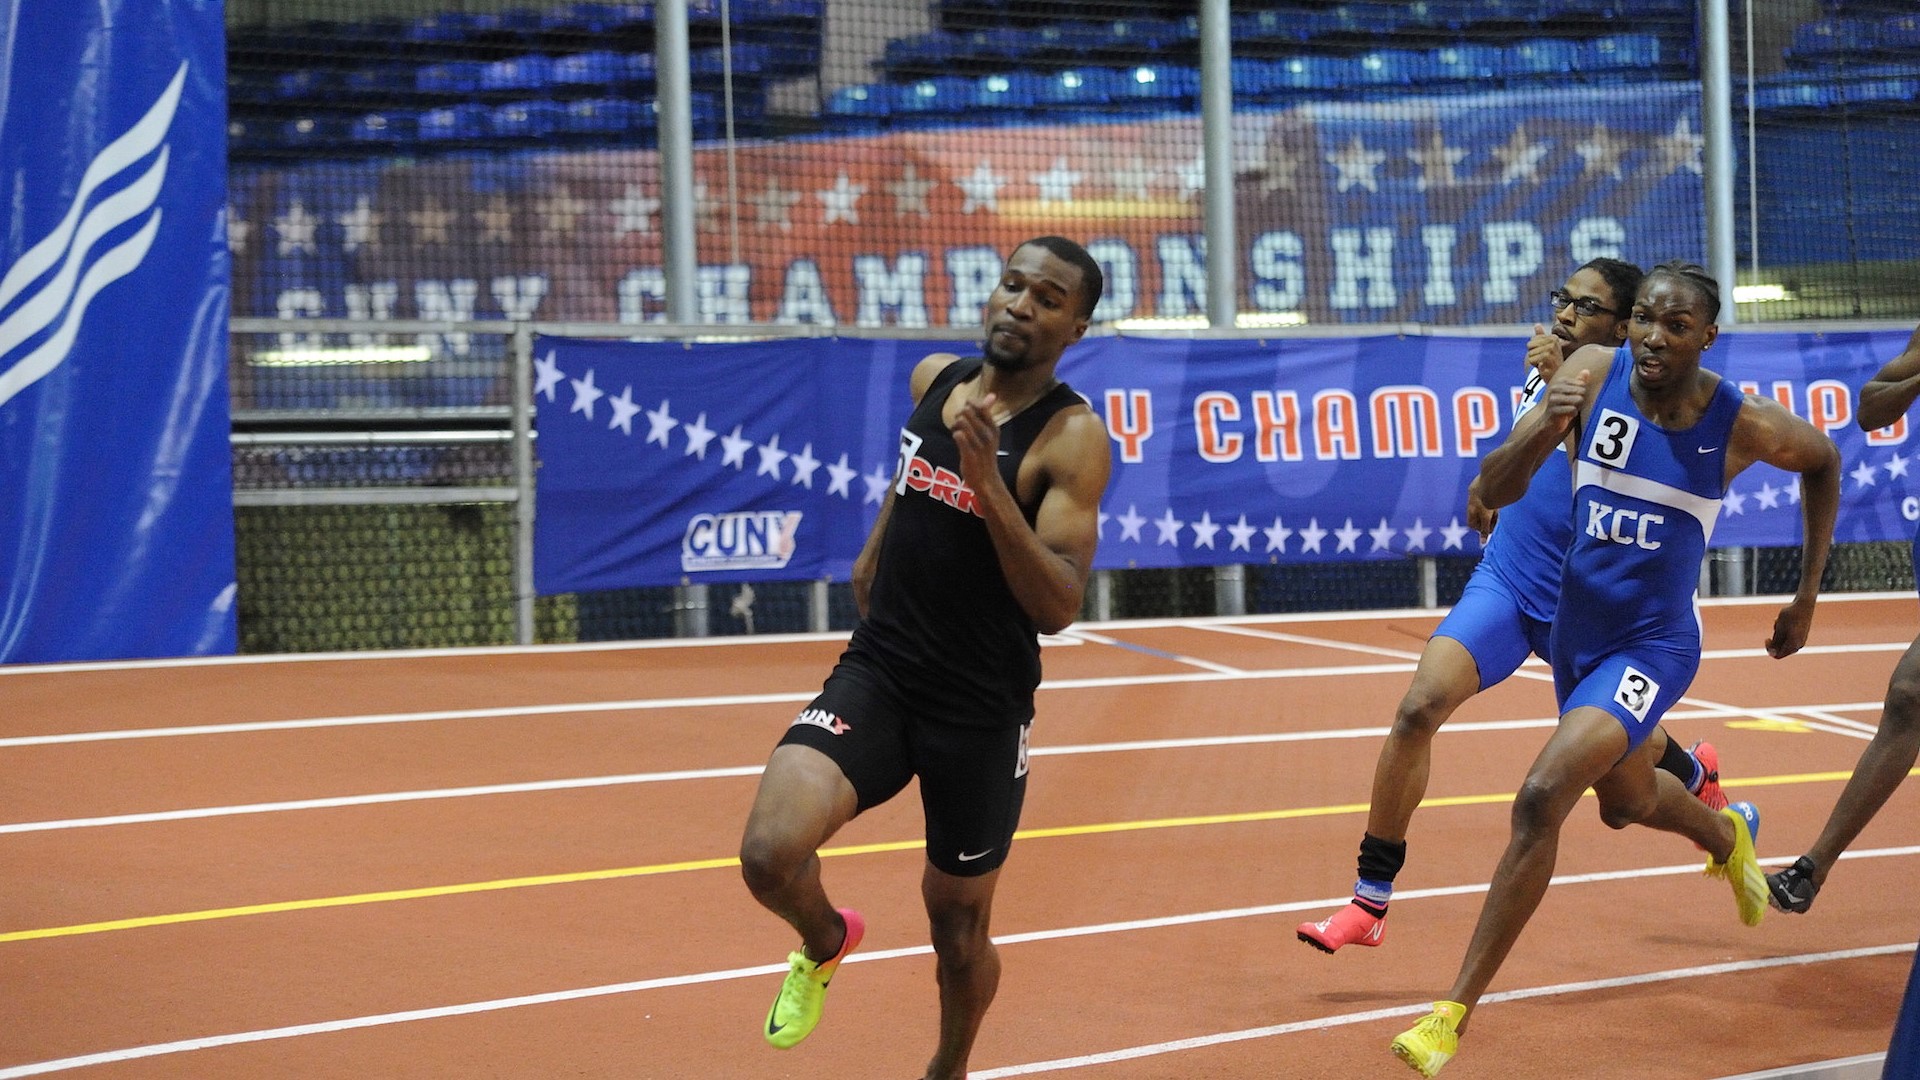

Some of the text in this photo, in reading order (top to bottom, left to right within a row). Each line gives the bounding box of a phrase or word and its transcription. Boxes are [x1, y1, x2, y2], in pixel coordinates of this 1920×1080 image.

[618, 215, 1627, 329] CHAMPONSHIPS
[1524, 374, 1542, 403] 4
[1594, 415, 1629, 461] 3
[684, 510, 803, 557] CUNY
[1585, 499, 1665, 551] KCC
[1620, 674, 1650, 712] 3
